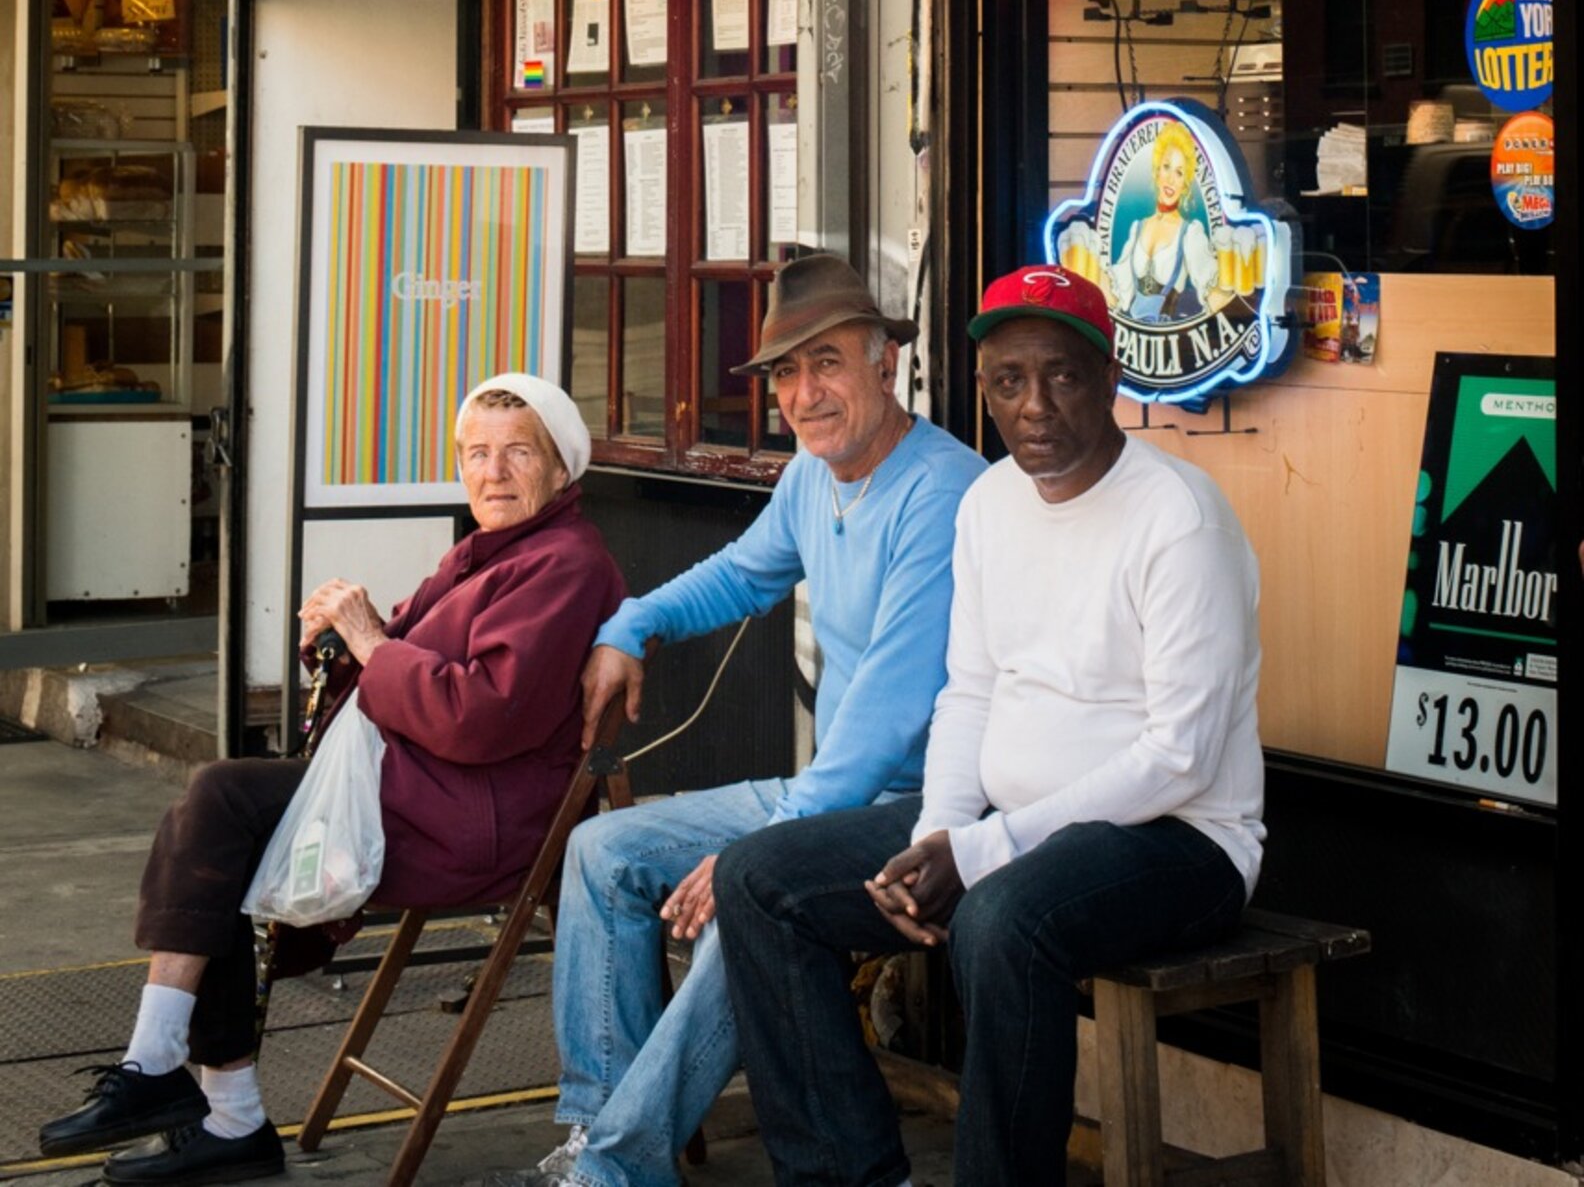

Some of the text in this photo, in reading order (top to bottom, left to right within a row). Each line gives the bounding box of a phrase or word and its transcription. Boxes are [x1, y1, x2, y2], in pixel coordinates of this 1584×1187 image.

[391, 271, 482, 310] Ginger
[1113, 312, 1245, 376] PAULI N.A.
[1432, 519, 1557, 622] Marlbor
[1416, 691, 1548, 785] $13.00
